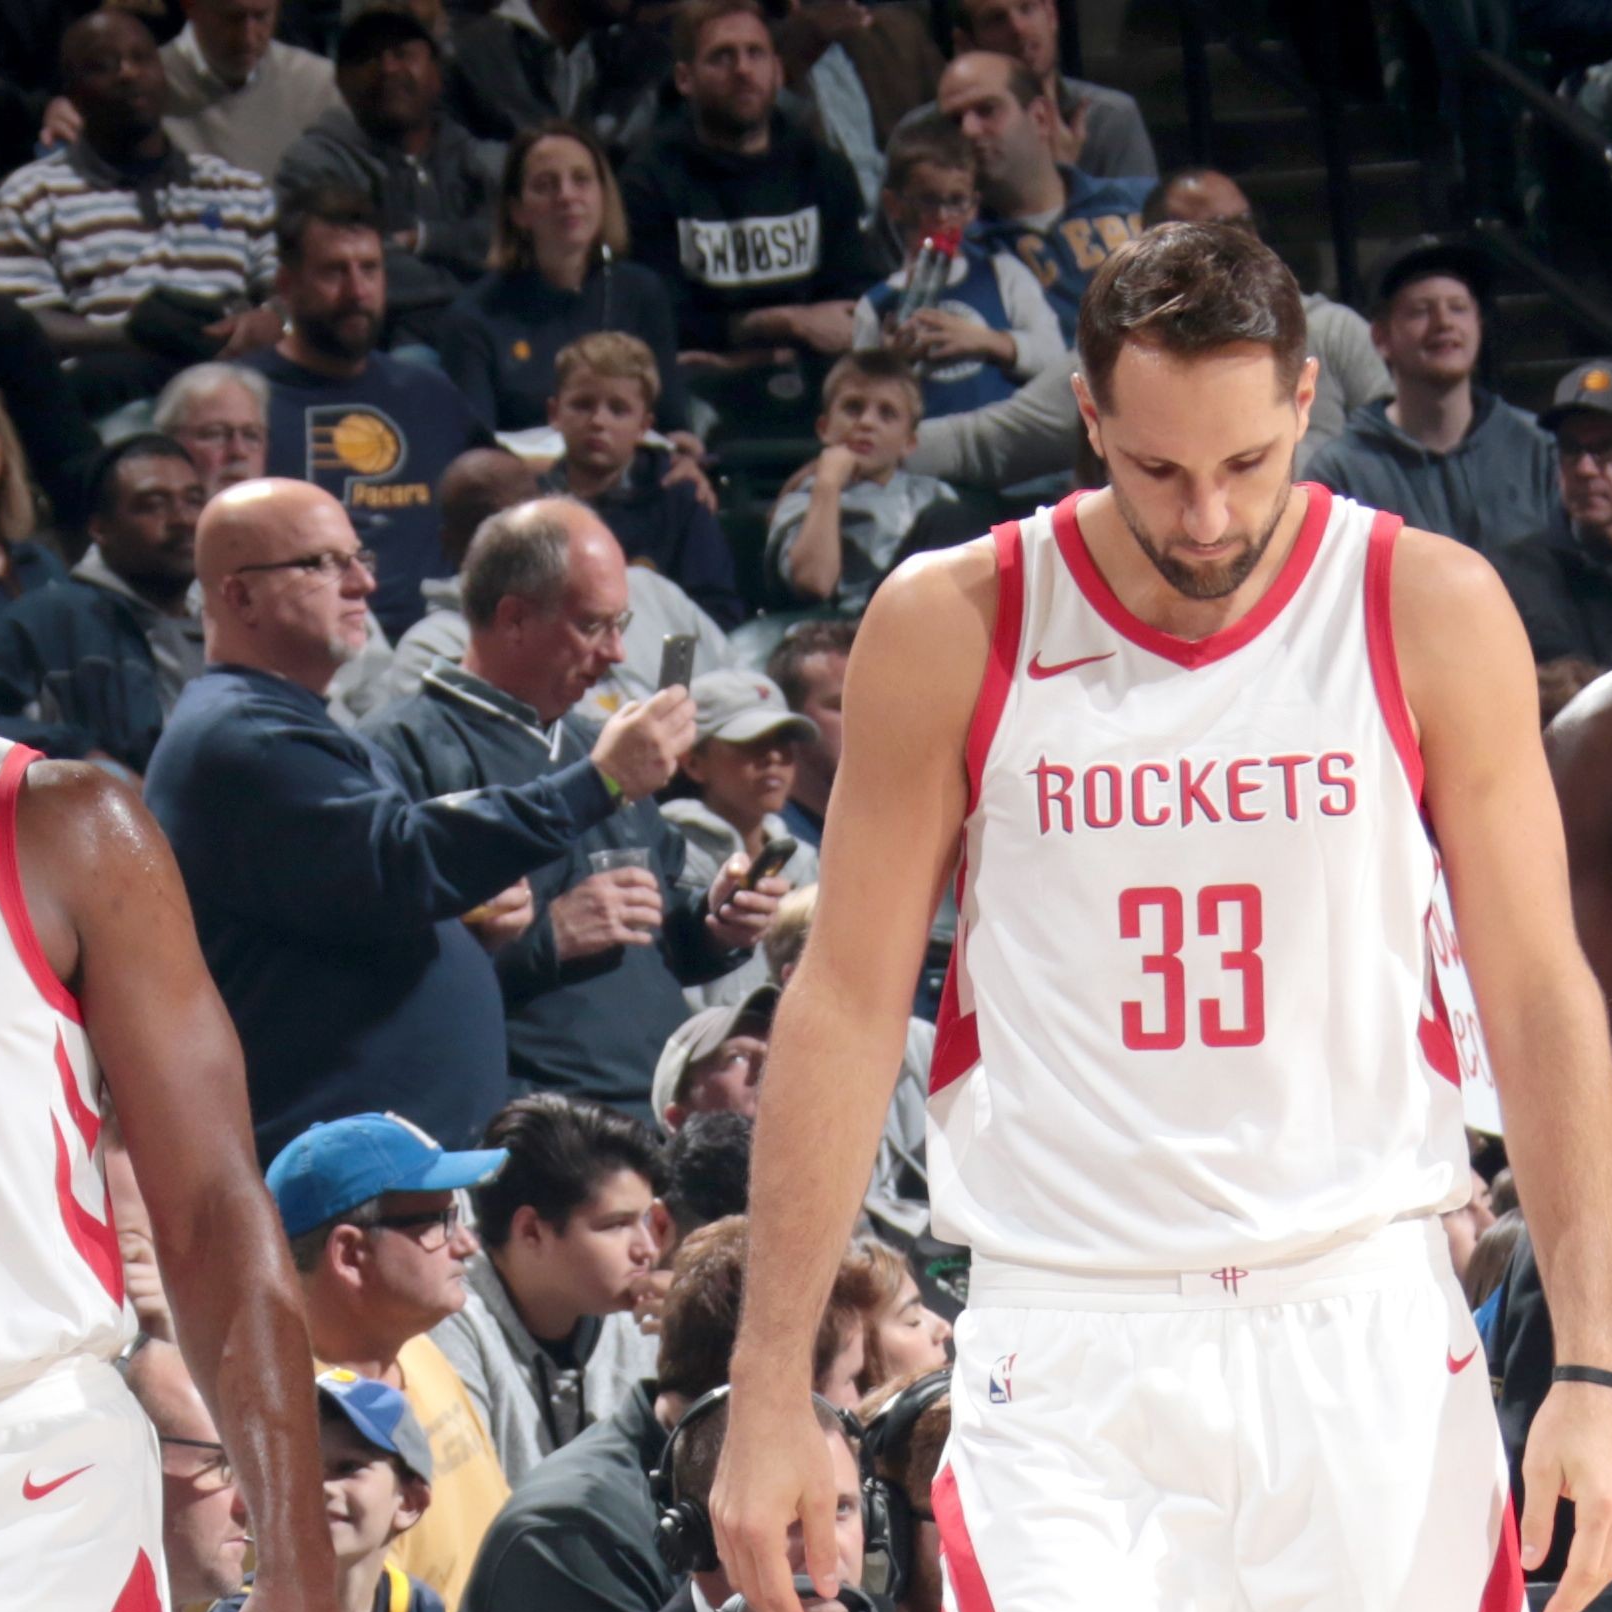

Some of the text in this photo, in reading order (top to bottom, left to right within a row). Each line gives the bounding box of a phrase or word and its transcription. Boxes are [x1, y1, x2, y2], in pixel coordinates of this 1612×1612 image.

[691, 217, 810, 274] SWOOSH
[352, 482, 430, 508] Pacers
[1028, 750, 1359, 836] ROCKETS
[1117, 883, 1266, 1050] 33
